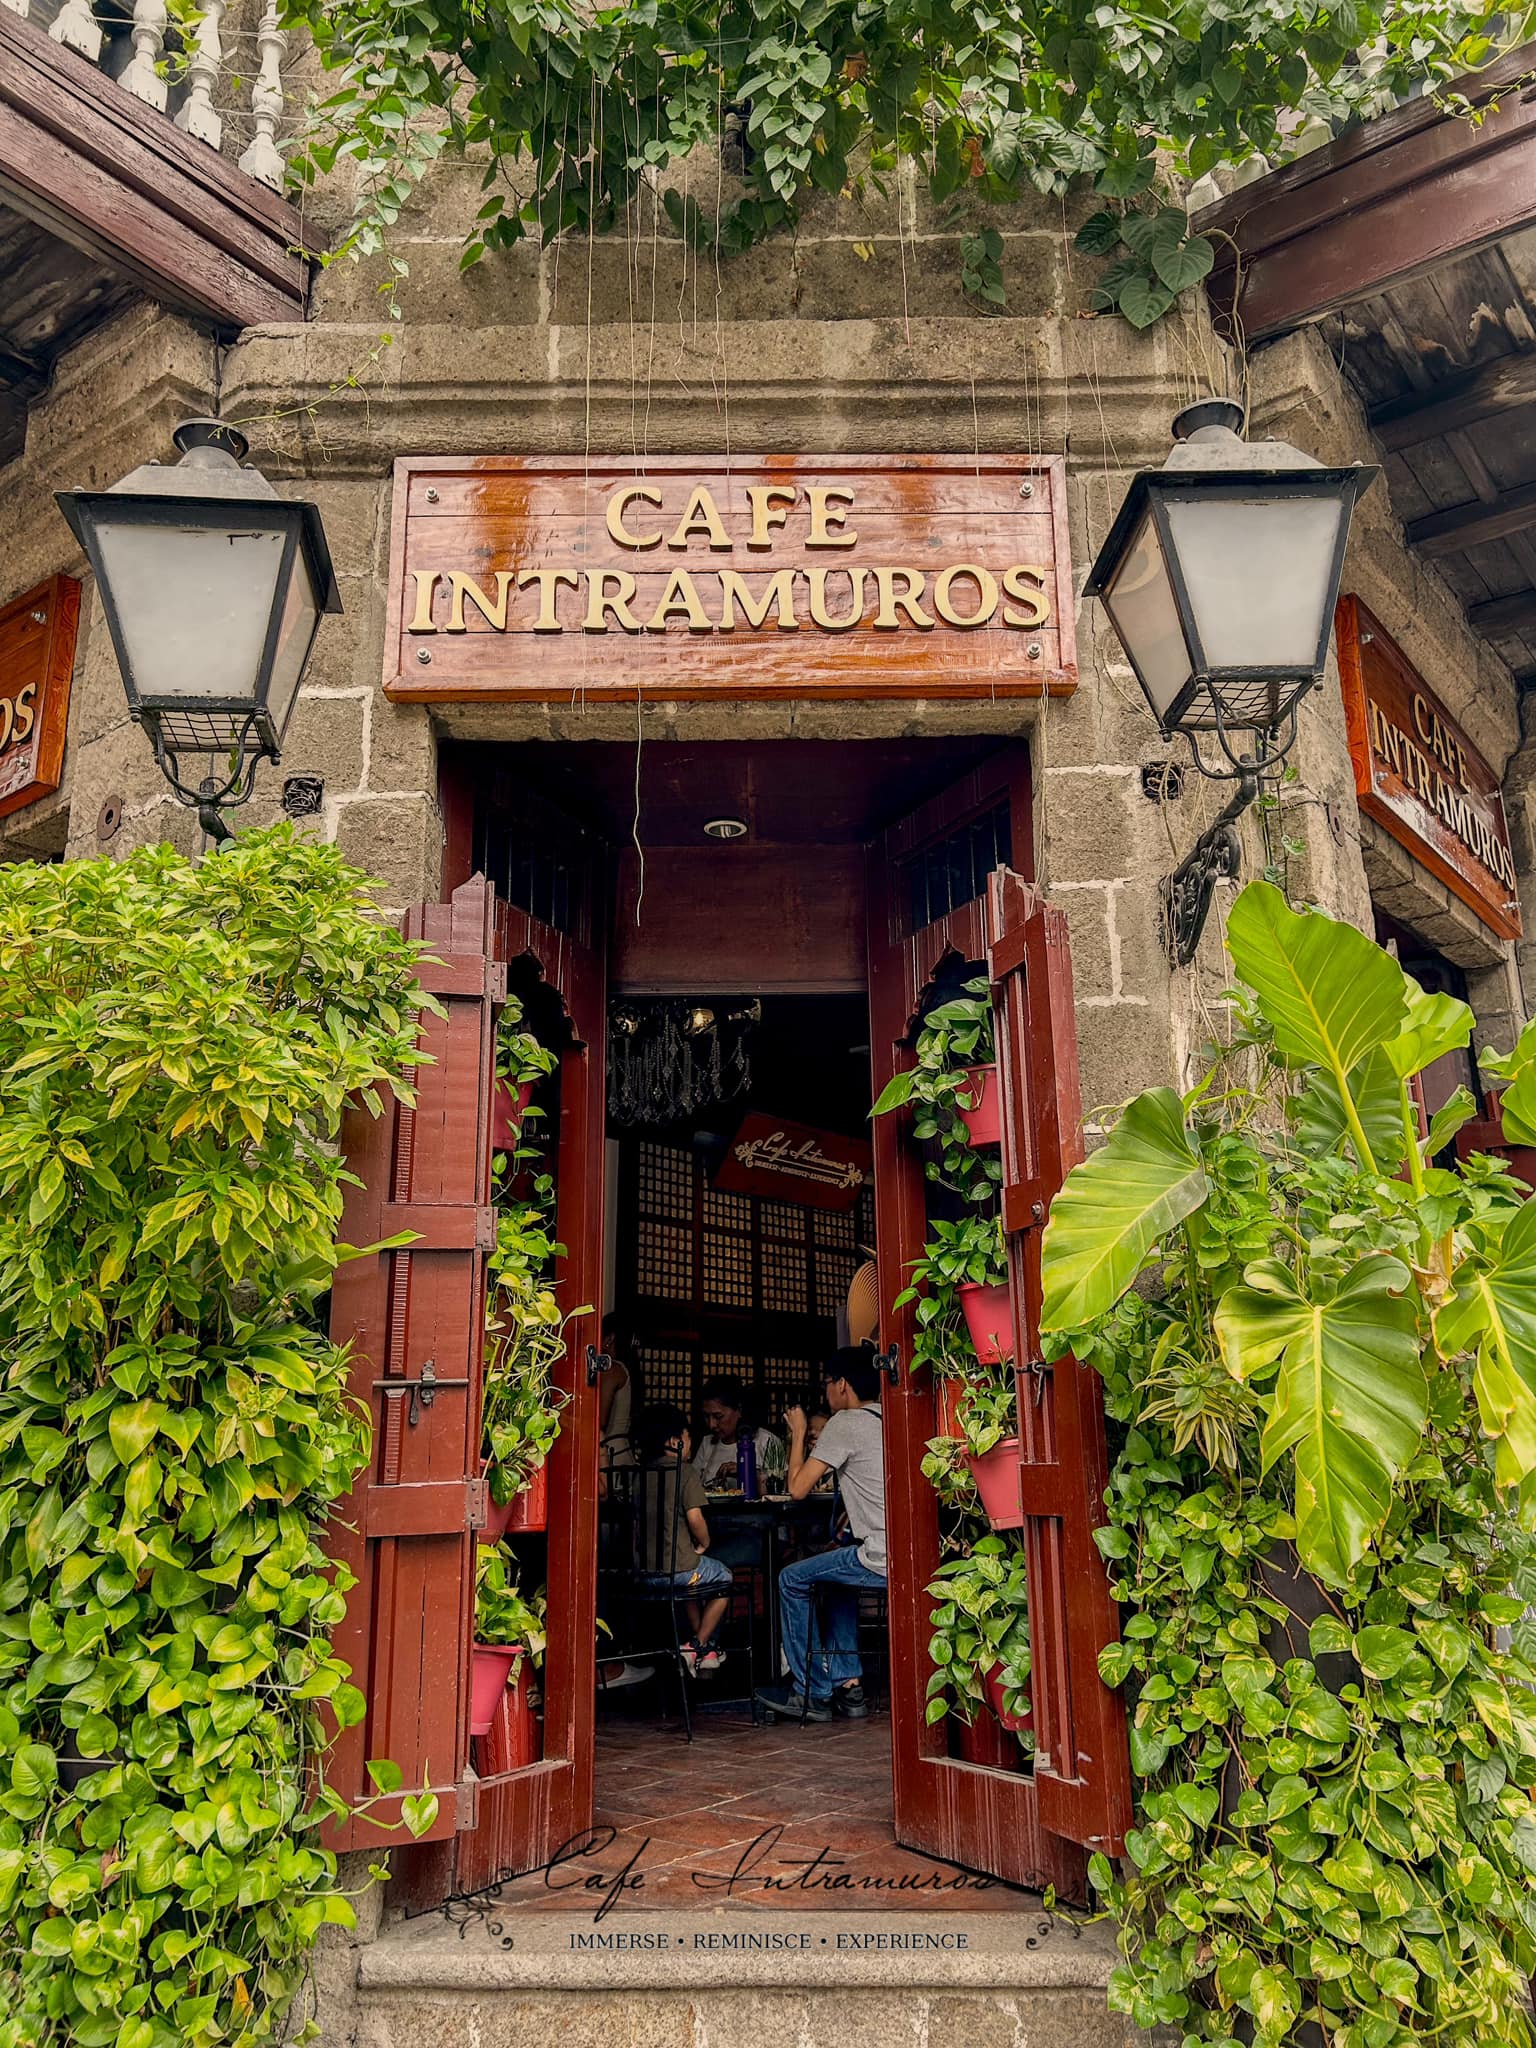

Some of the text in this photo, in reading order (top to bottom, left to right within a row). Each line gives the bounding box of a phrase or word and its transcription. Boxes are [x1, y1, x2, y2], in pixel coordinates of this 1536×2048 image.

[606, 486, 858, 551] CAFE
[408, 564, 1051, 633] INTRAMUROS
[1414, 693, 1471, 793] CAFE
[1368, 698, 1514, 891] INTRAMUROS
